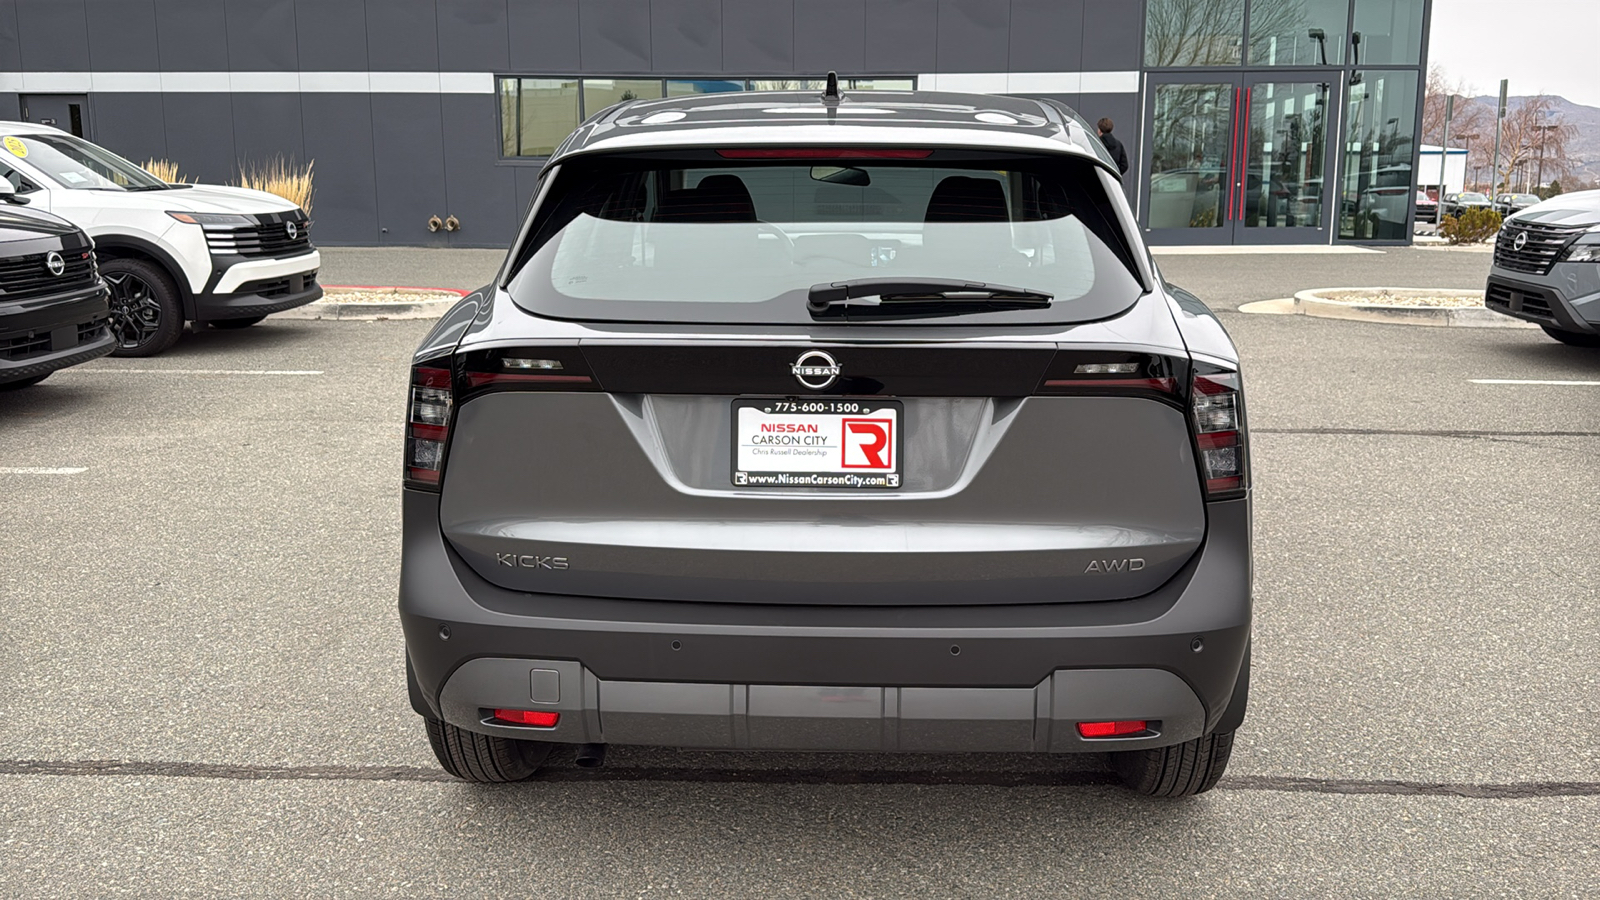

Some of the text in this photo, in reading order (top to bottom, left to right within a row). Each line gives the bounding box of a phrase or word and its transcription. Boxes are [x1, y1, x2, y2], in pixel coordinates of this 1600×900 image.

[792, 367, 840, 375] NISSAN
[775, 402, 859, 413] 775-600-1500
[761, 423, 818, 433] NISSAN
[751, 434, 828, 446] CARSON CITY
[848, 423, 887, 467] R
[752, 448, 828, 457] Chris Russell Dealership
[748, 473, 885, 487] www.NissanCarsonCity.com
[496, 552, 569, 570] KICKS
[1083, 558, 1146, 573] AWD
